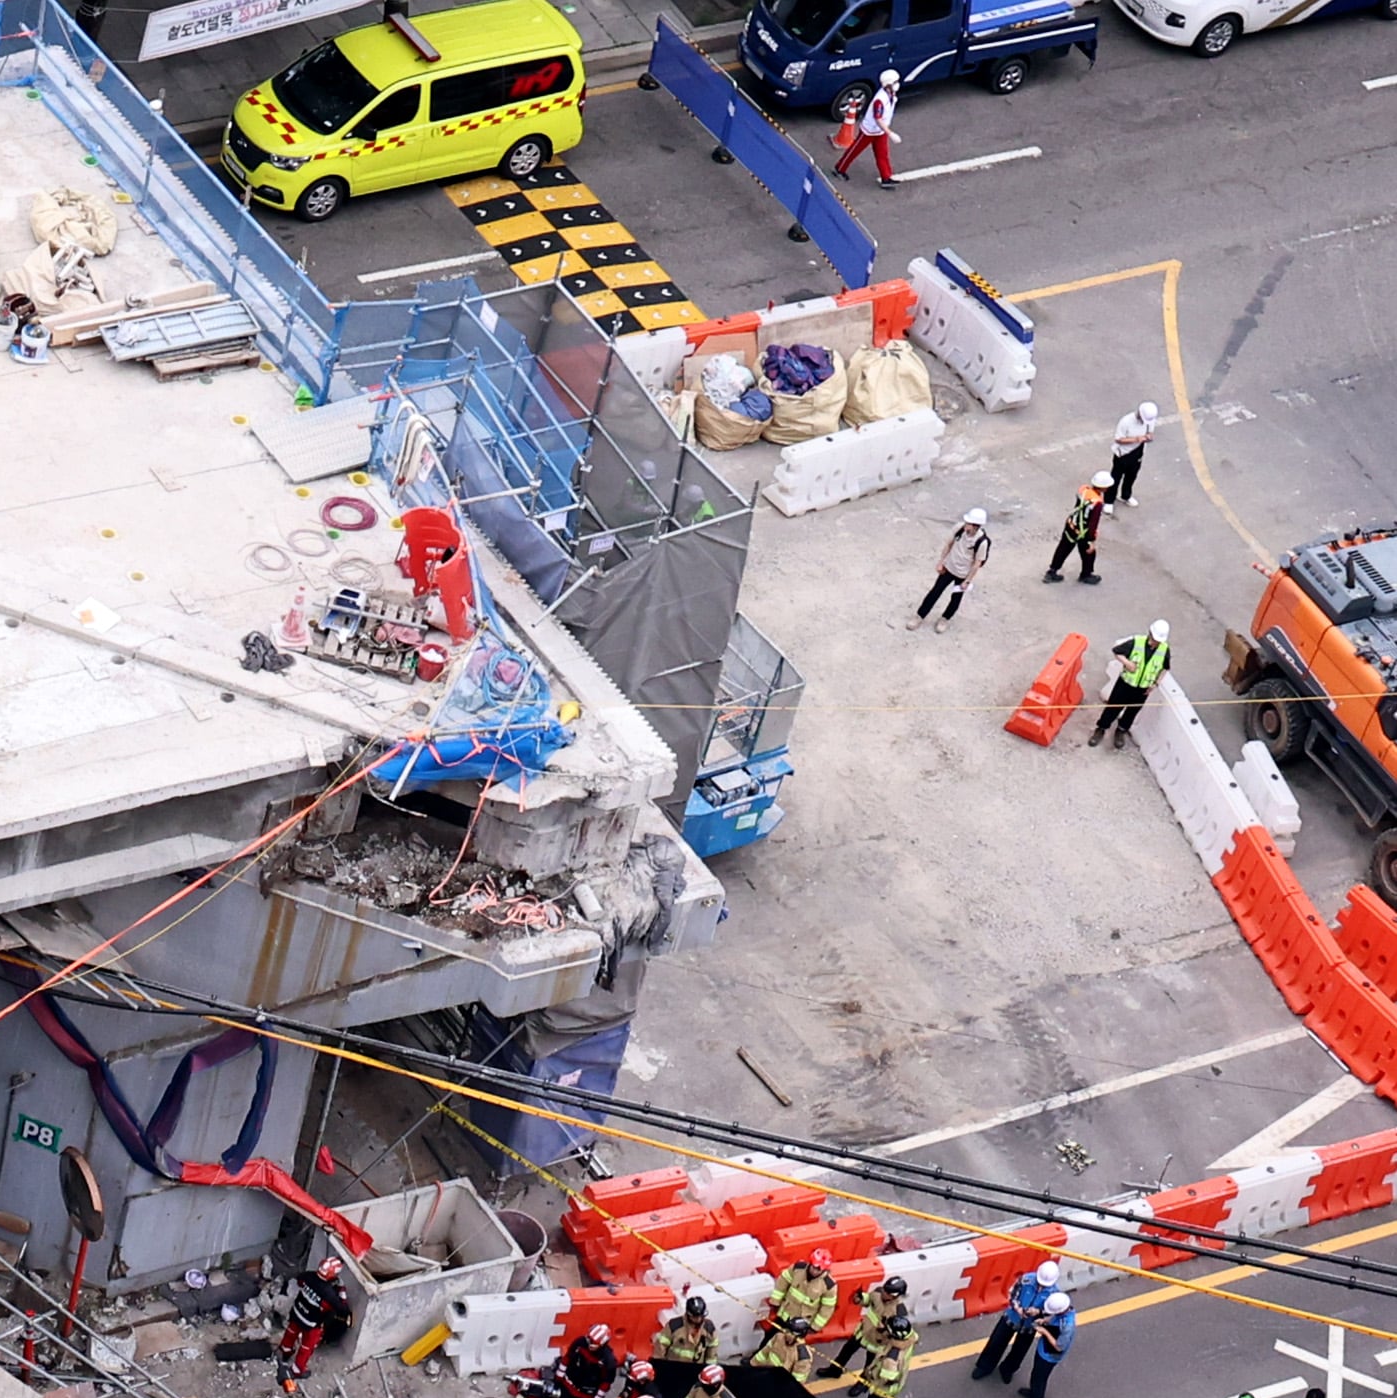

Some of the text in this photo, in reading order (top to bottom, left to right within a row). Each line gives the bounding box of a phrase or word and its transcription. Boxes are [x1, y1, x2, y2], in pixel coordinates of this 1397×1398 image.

[167, 12, 233, 41] 철도건널목
[828, 58, 862, 71] KORAIL
[509, 61, 563, 97] 119
[22, 1119, 55, 1147] P8
